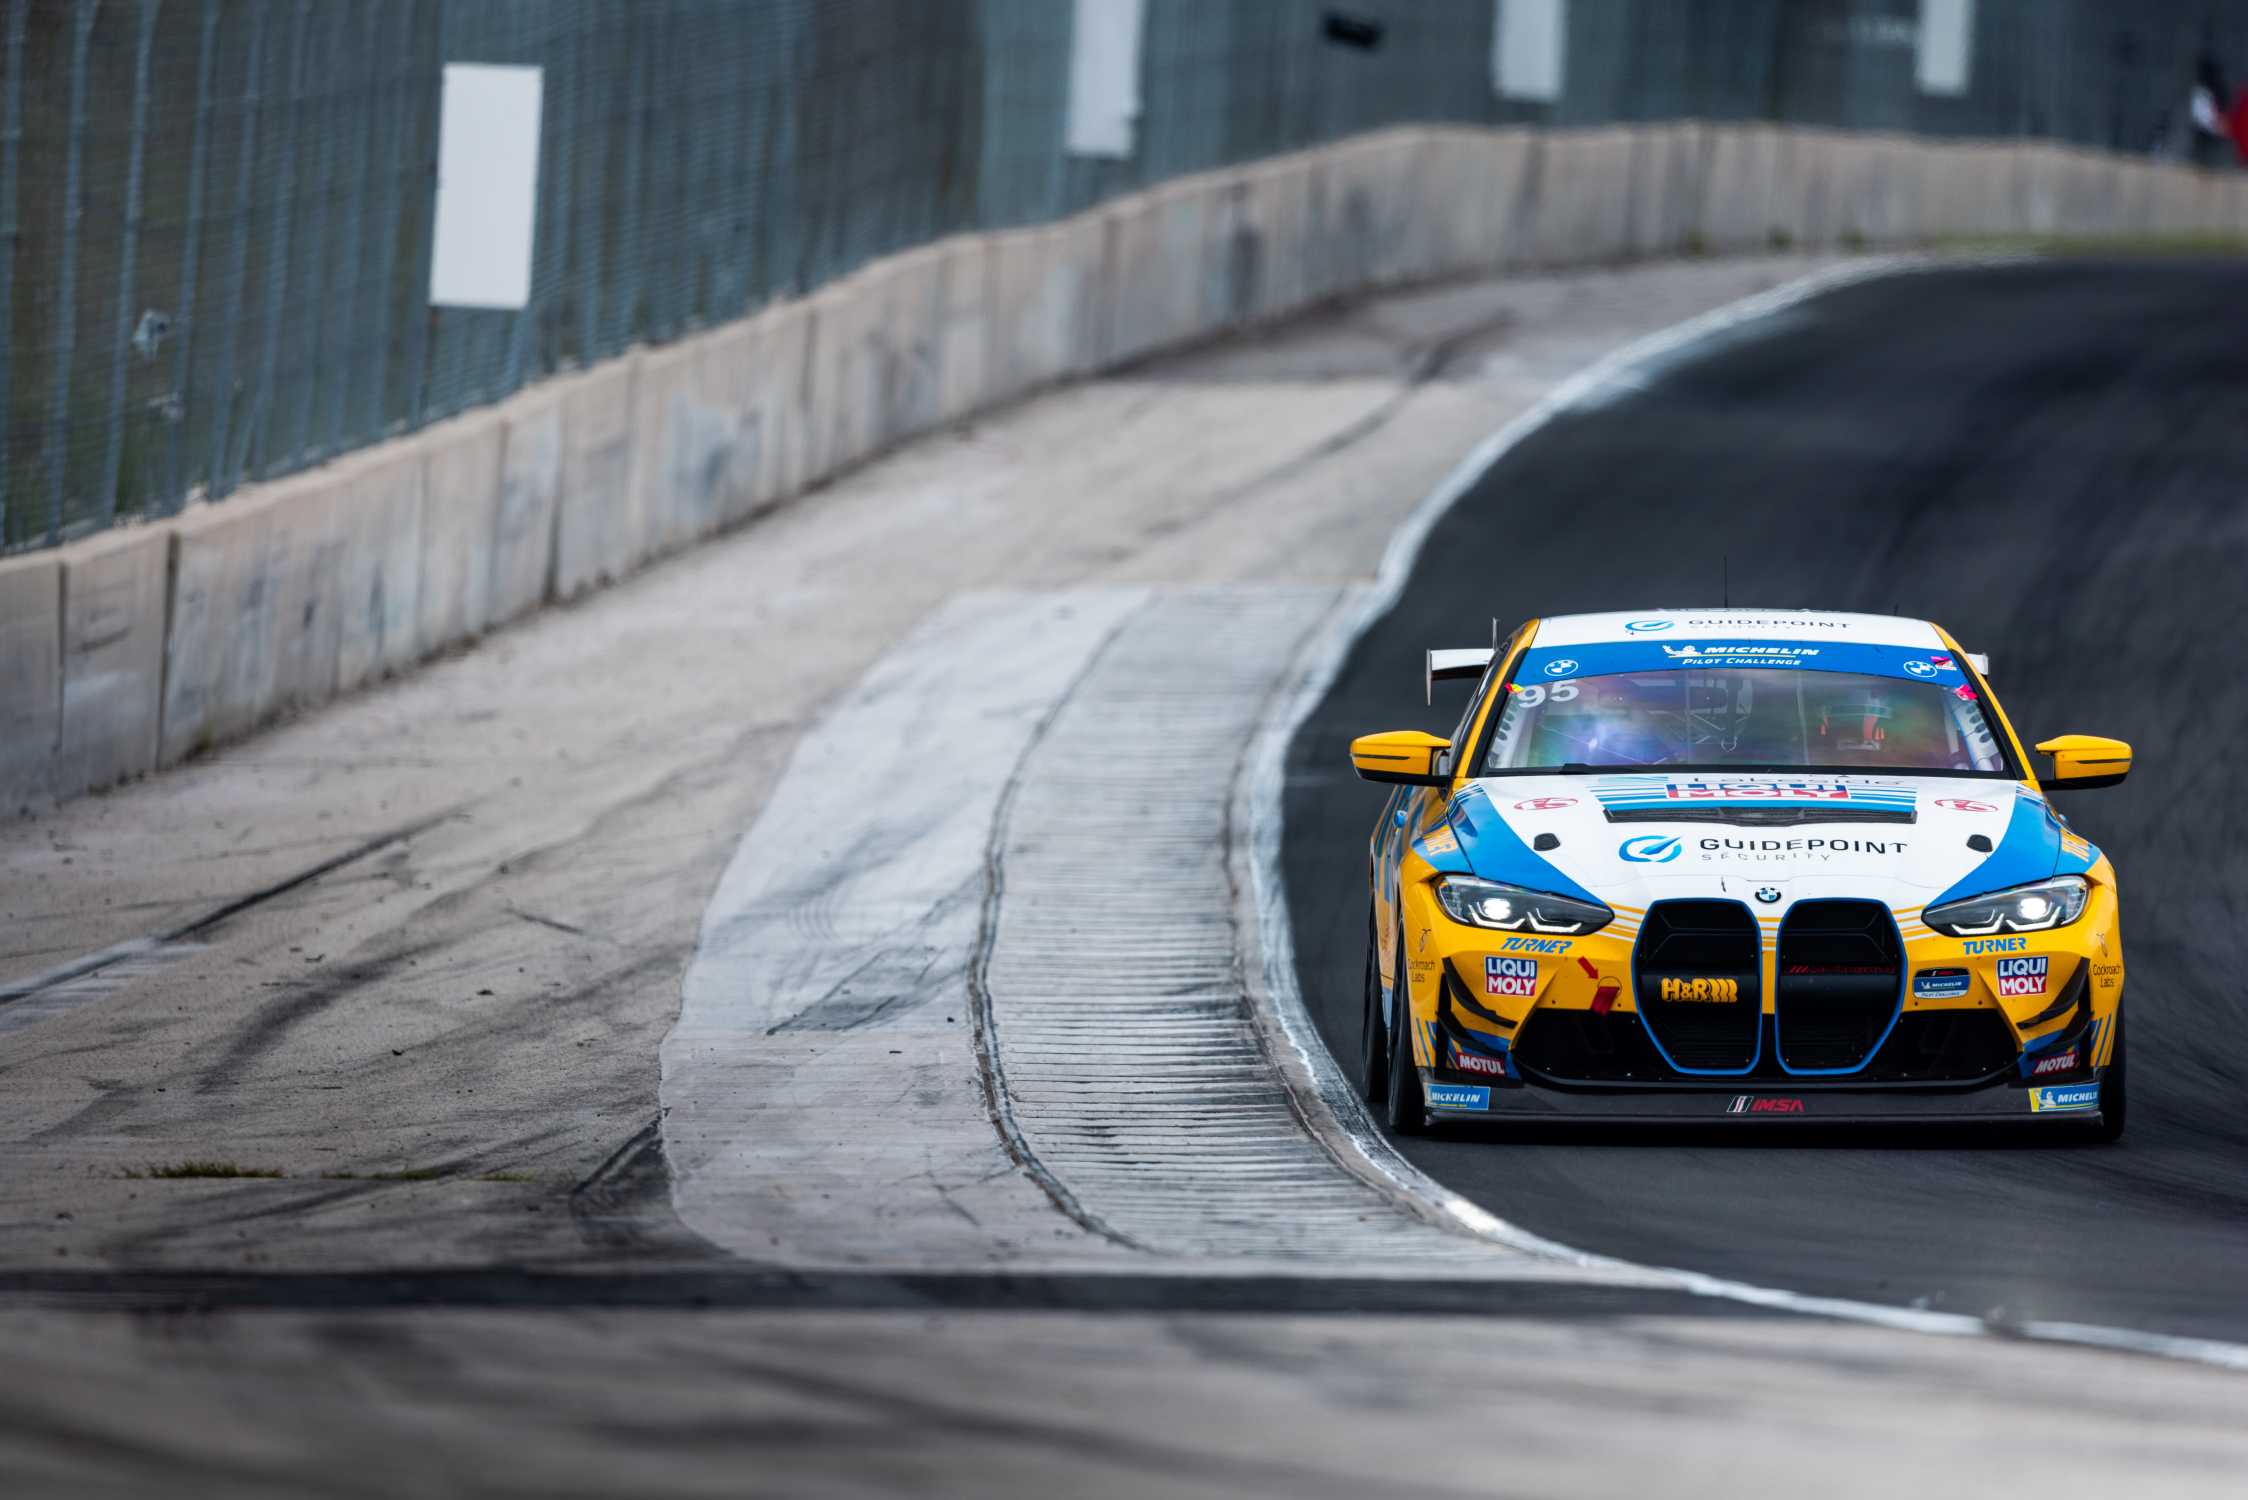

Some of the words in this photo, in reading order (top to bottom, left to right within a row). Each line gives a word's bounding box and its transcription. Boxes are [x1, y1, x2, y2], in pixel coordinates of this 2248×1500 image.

[1704, 646, 1820, 656] MICHELIN
[1682, 657, 1722, 665] PILOT
[1726, 657, 1802, 666] CHALLENGE
[1517, 678, 1580, 708] 95
[1699, 838, 1908, 854] GUIDEPOINT
[1501, 937, 1573, 954] TURNER
[1963, 937, 2026, 955] TURNER
[1487, 958, 1536, 977] LIQUI
[2000, 957, 2047, 977] LIQUI
[1487, 977, 1536, 995] MOLY
[2000, 976, 2047, 995] MOLY
[1459, 1055, 1505, 1074] MOTUL
[2034, 1054, 2076, 1073] MOTUL
[1751, 1098, 1806, 1112] IMSA
